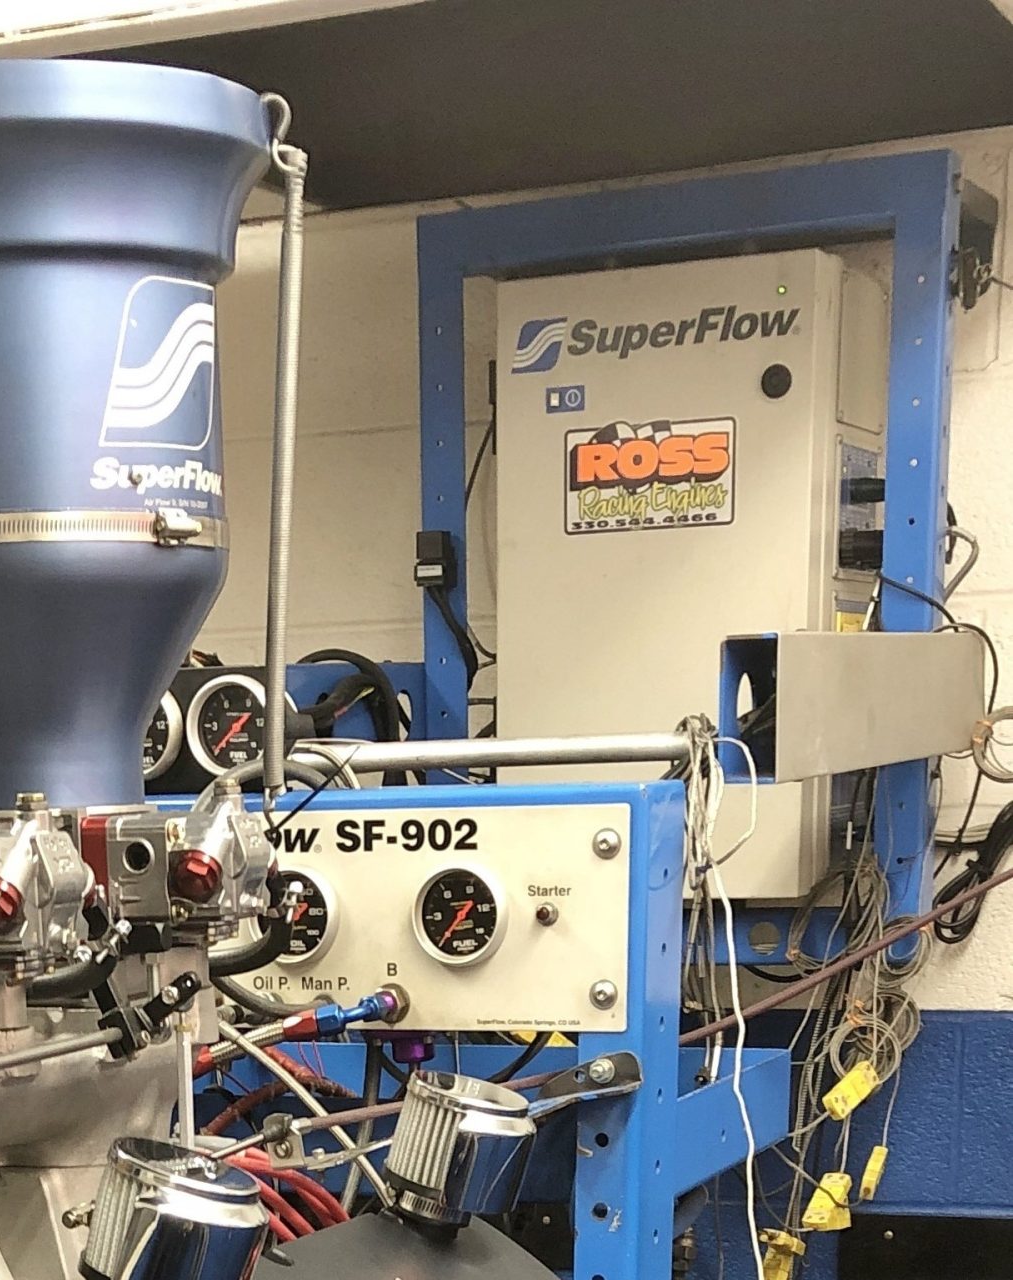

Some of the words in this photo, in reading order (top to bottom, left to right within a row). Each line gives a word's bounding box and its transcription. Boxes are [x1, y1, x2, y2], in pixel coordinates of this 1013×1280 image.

[567, 305, 801, 359] SuperFlow
[576, 431, 730, 484] ROSS
[578, 484, 648, 522] Racing
[650, 477, 728, 520] Engines
[571, 512, 718, 531] 330.544.4466
[156, 720, 166, 730] 12
[212, 721, 218, 731] 3
[229, 751, 248, 759] FUEL
[335, 818, 479, 853] SF-902
[527, 884, 573, 897] Starter
[476, 903, 491, 913] 12
[433, 911, 443, 921] 3
[290, 939, 306, 948] OIL
[452, 939, 479, 949] FUEL
[386, 963, 398, 976] B
[253, 976, 273, 991] Oil
[278, 977, 291, 991] P.
[301, 977, 333, 991] Man
[337, 977, 351, 991] P.
